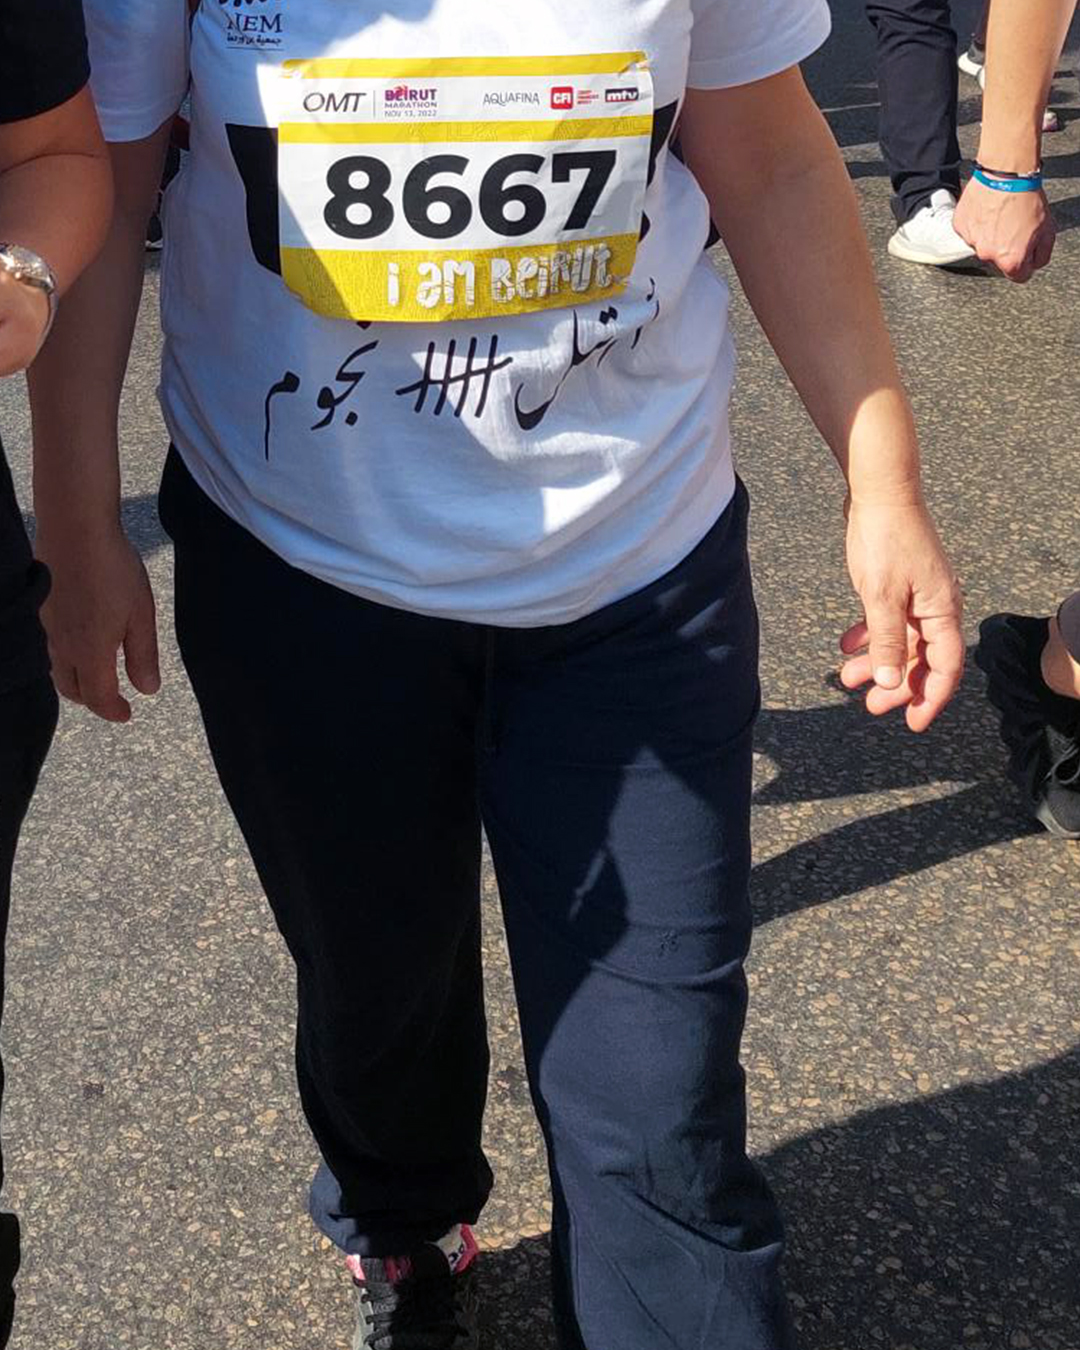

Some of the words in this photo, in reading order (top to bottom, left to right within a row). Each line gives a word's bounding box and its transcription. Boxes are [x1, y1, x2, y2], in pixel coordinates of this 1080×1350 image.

[384, 84, 438, 102] BEIRUT
[482, 91, 541, 107] AQUAFINA
[302, 92, 367, 113] OMT
[384, 101, 438, 109] MARATHON
[322, 149, 618, 241] 8667
